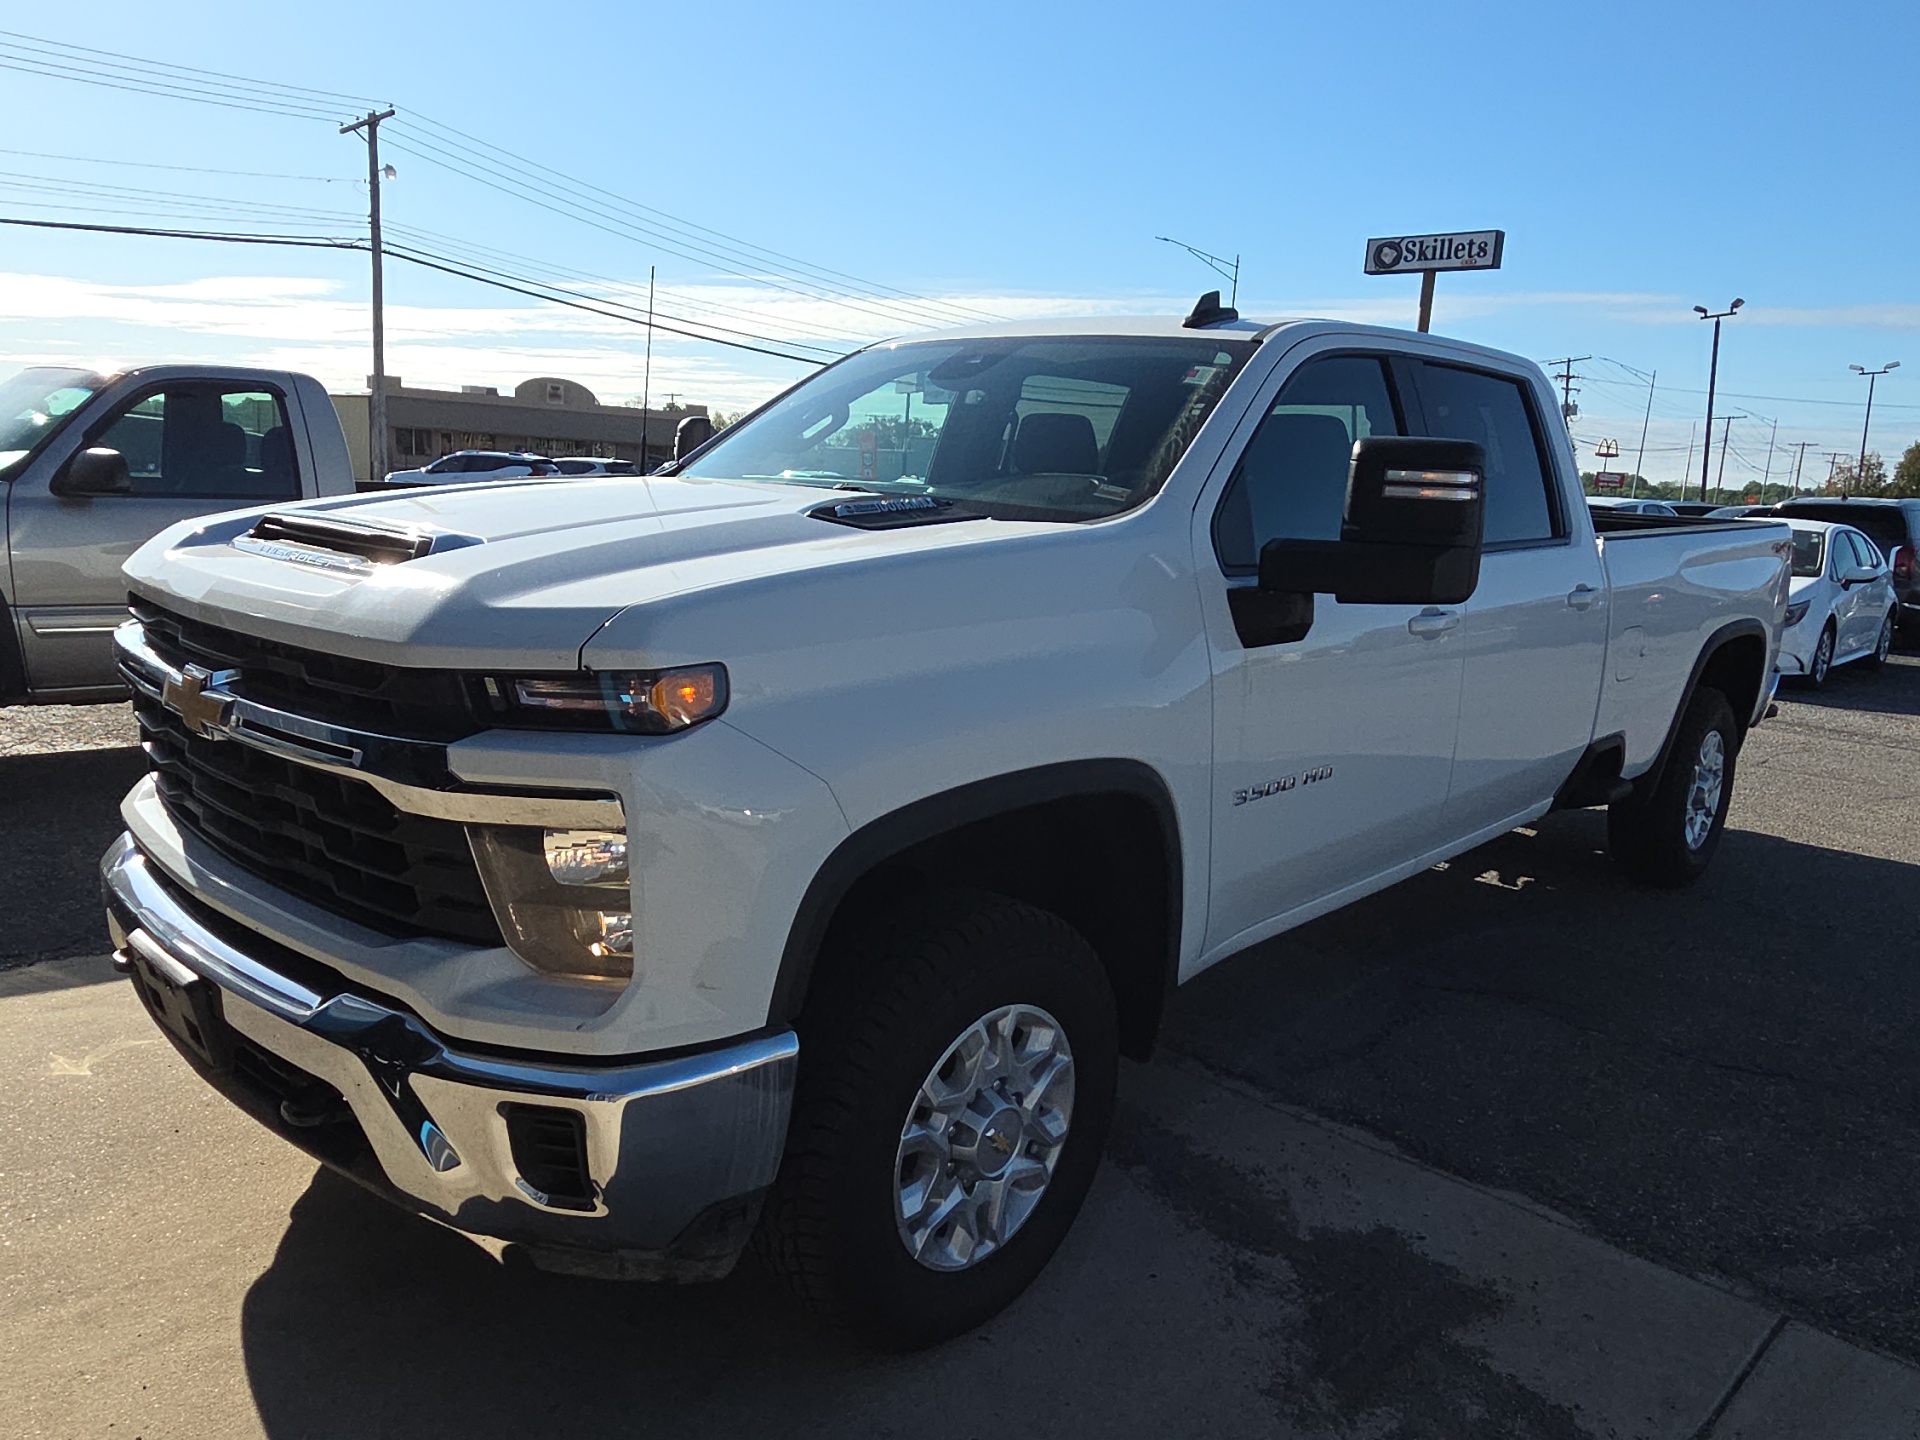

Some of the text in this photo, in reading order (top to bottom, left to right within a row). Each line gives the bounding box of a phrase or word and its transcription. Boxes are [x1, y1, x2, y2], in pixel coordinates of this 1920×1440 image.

[1403, 236, 1488, 262] Skillets
[1233, 767, 1333, 806] 3500 HD
